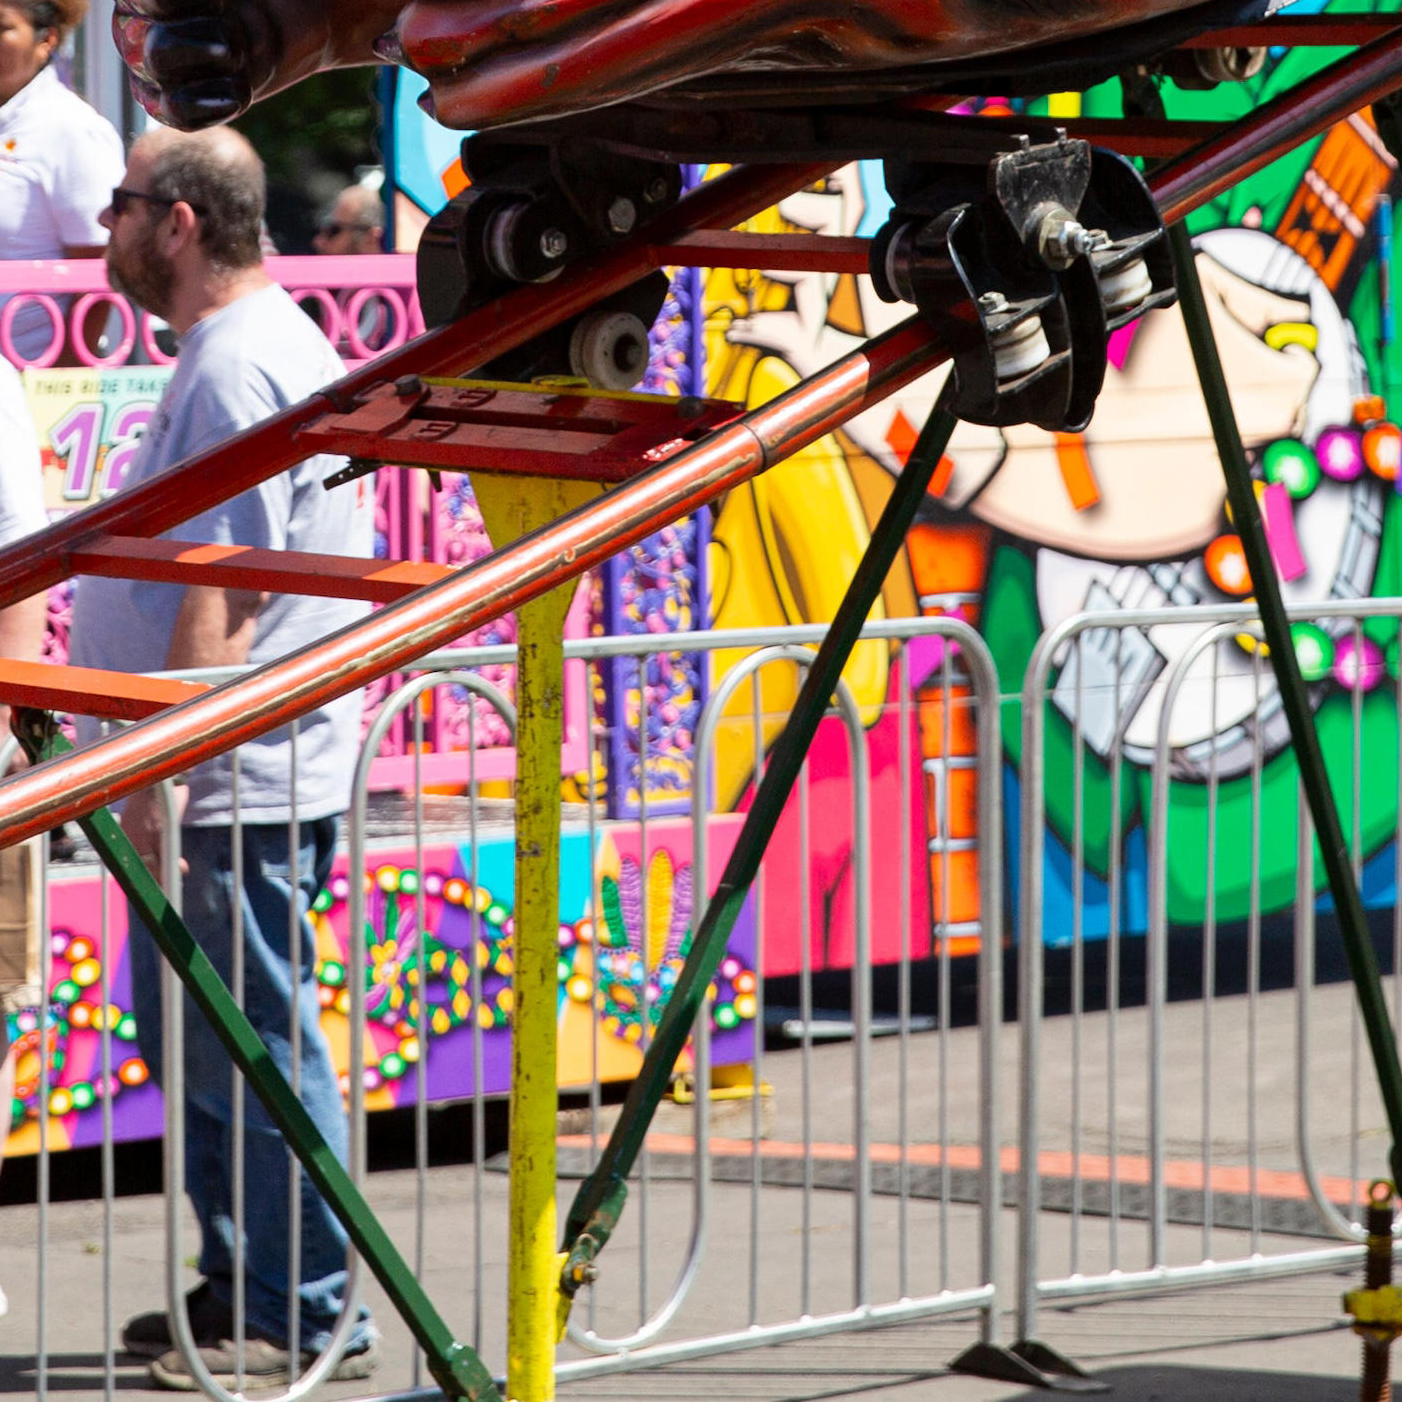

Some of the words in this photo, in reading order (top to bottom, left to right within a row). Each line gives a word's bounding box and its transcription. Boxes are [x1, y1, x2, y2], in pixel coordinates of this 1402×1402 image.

[36, 378, 72, 394] THIS
[82, 378, 118, 394] RIDE
[126, 378, 170, 394] TAKE
